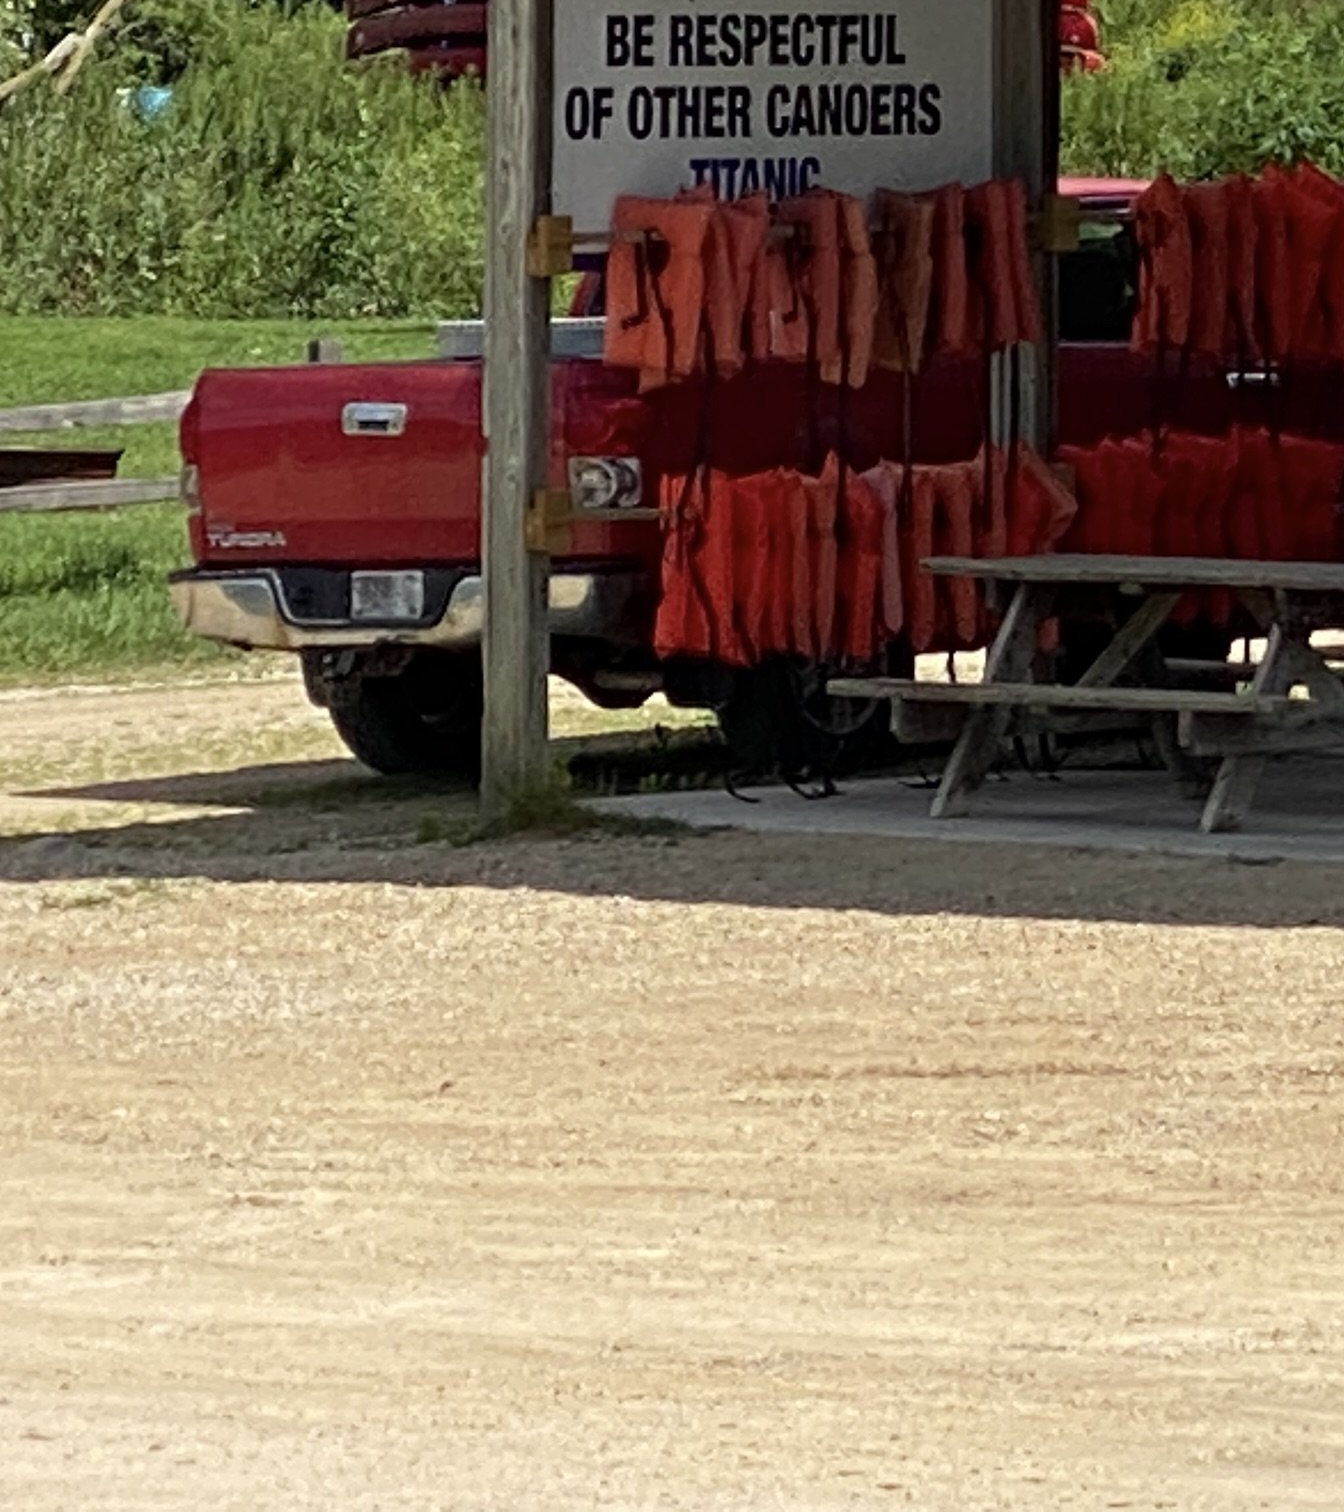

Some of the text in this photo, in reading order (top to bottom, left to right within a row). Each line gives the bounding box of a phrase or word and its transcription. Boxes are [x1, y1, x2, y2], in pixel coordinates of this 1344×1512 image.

[606, 12, 907, 67] BE RESPECTFUL
[565, 82, 943, 141] OF OTHER CANOERS
